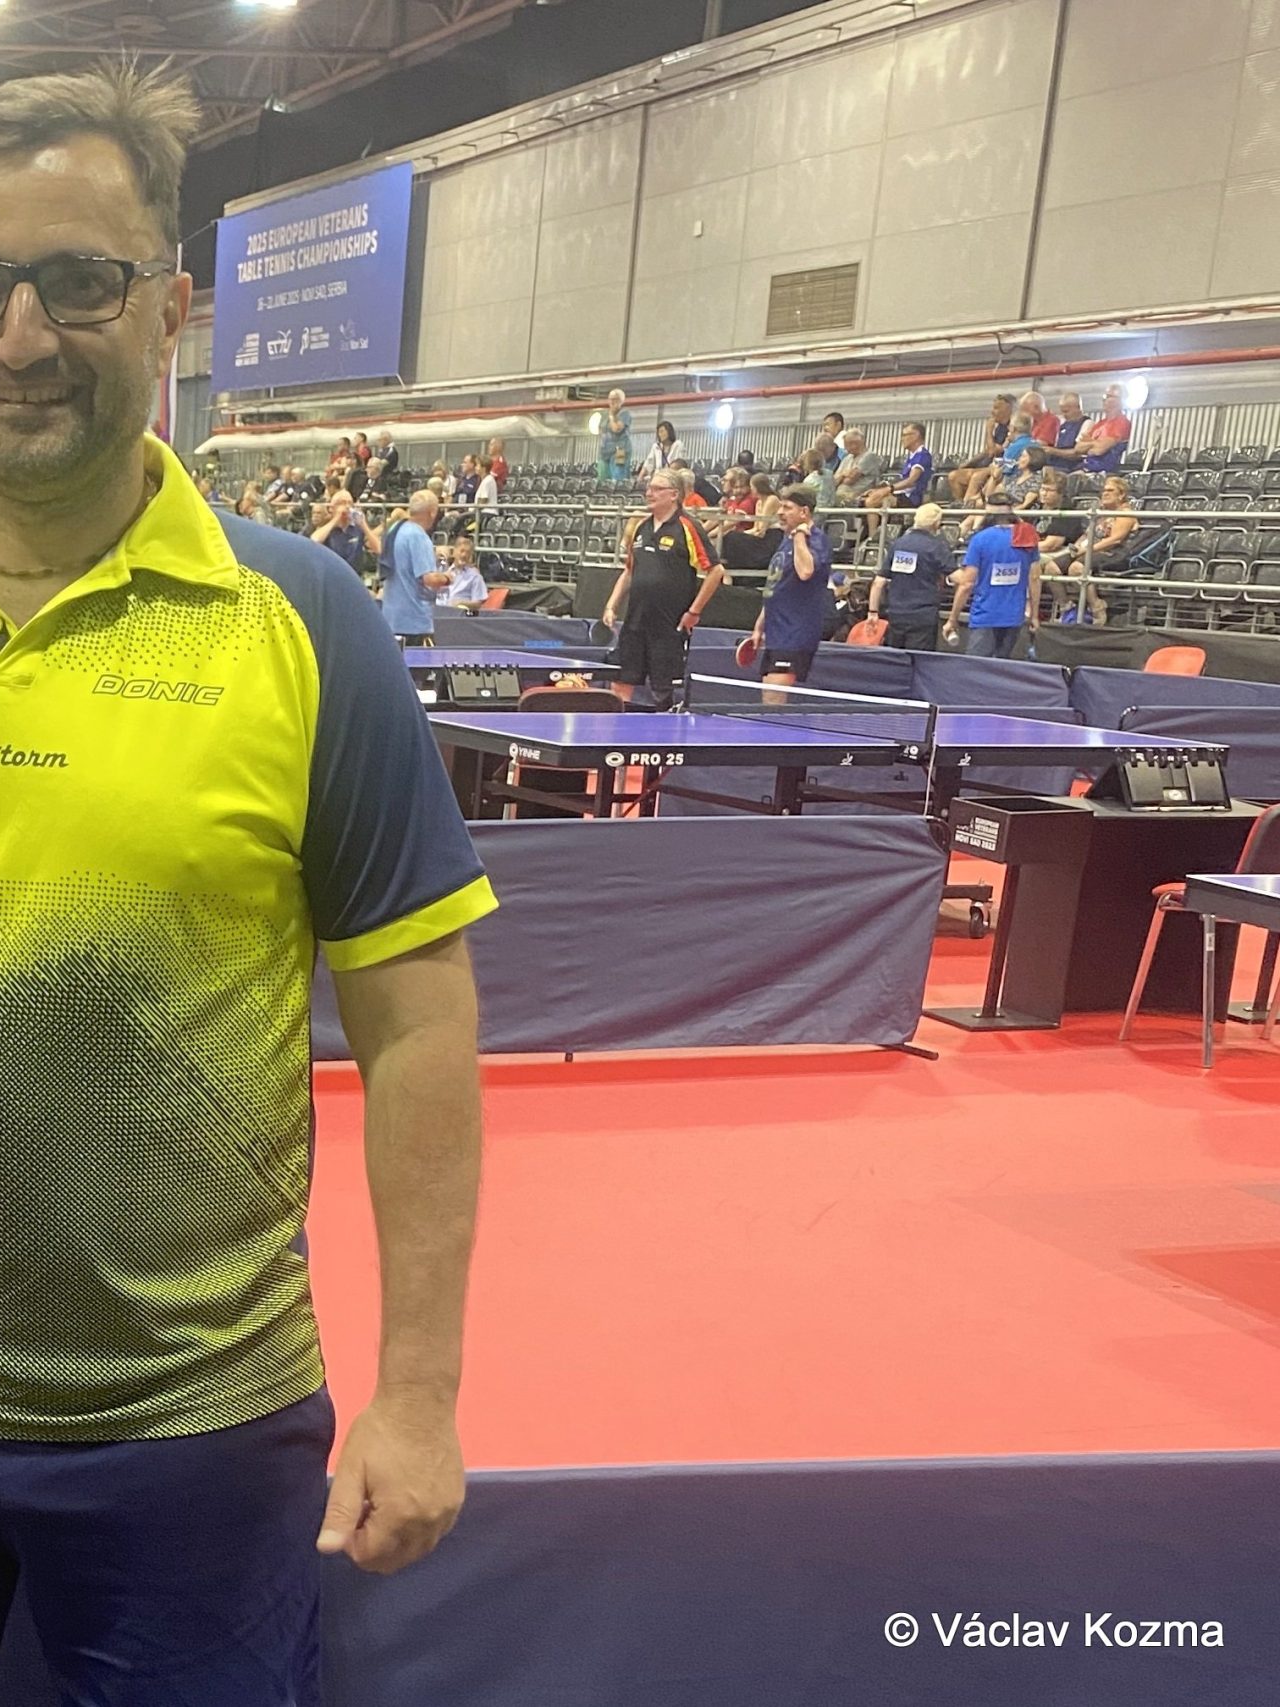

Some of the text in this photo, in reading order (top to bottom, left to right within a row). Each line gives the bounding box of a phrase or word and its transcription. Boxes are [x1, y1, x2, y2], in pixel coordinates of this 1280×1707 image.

[247, 203, 368, 255] 2025 EUROPEAN VETERANS
[237, 230, 378, 284] TABLE TENNIS CHAMPIONSHIPS
[92, 674, 224, 706] DONIC
[630, 753, 685, 765] PRO 25
